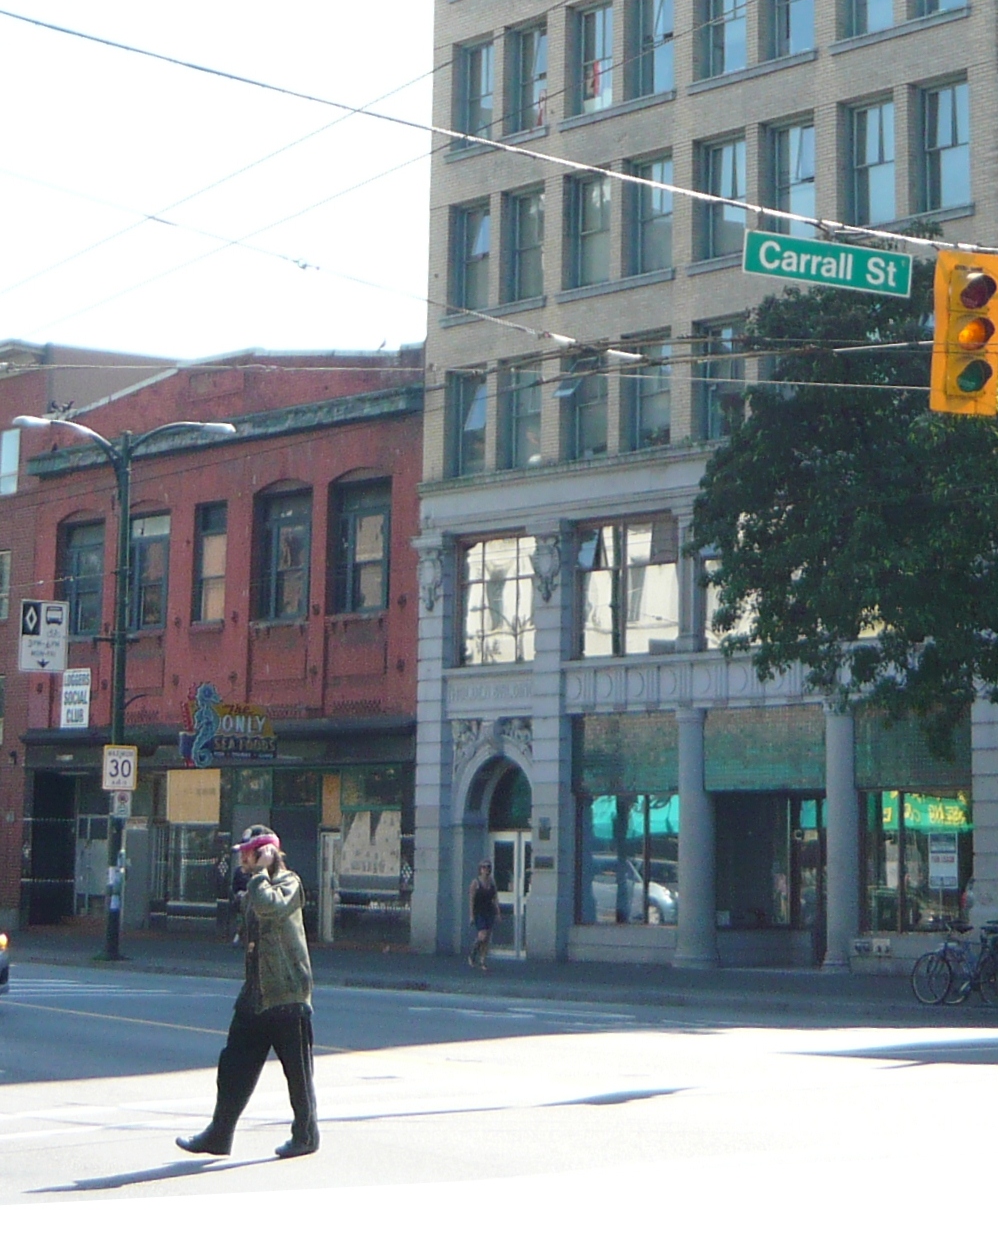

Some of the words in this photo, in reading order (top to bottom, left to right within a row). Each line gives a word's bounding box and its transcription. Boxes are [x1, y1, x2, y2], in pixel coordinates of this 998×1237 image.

[758, 240, 853, 280] Carrall
[865, 256, 897, 287] St
[64, 689, 88, 705] SOCIAL
[66, 708, 84, 723] CLUB
[221, 703, 252, 715] The
[222, 714, 266, 733] ONLY
[108, 758, 132, 778] 30
